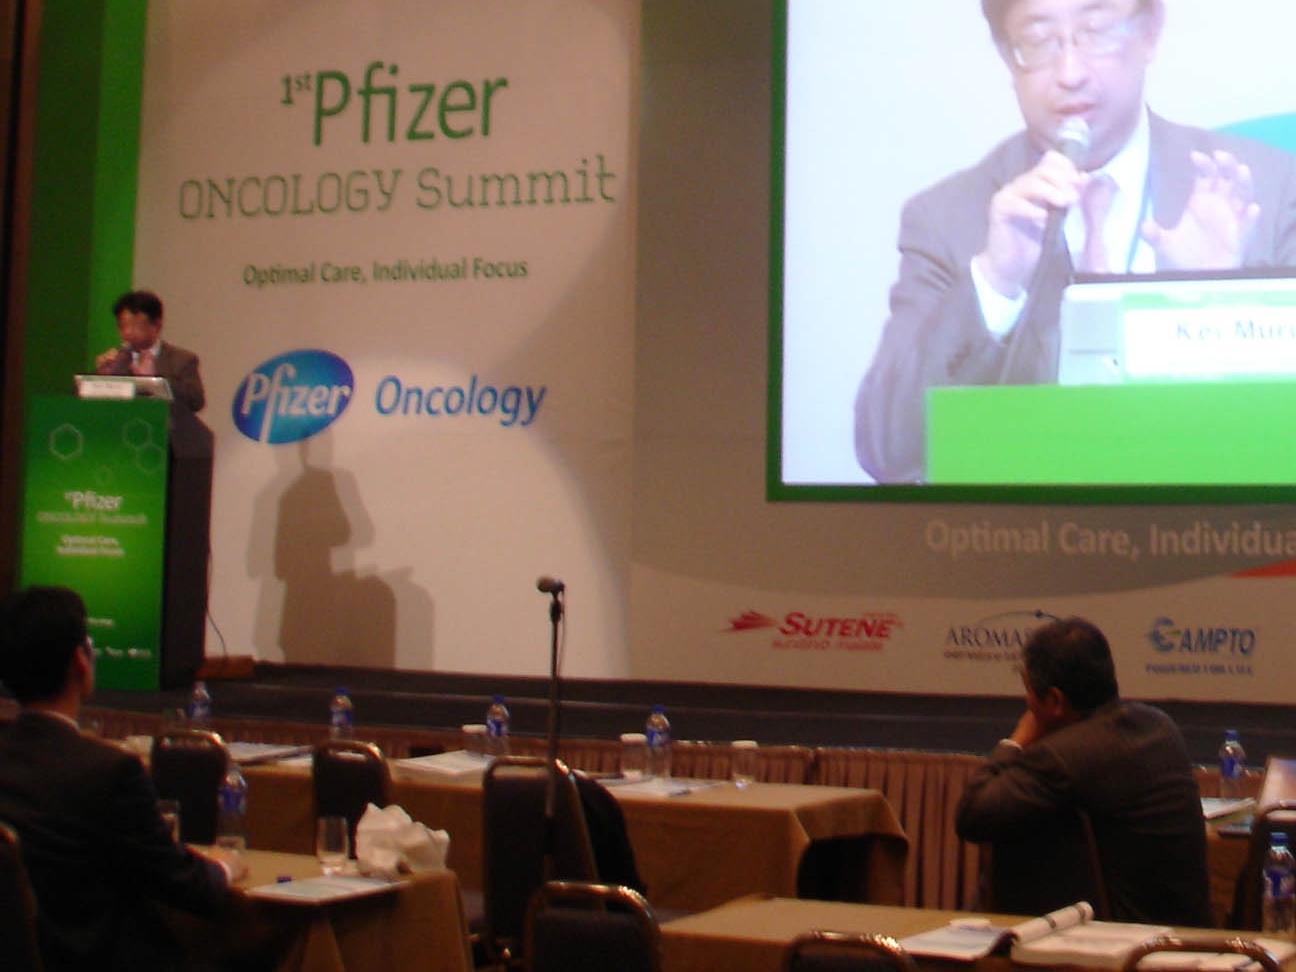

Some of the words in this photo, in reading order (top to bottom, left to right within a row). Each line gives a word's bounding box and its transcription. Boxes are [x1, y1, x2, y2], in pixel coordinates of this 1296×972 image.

[180, 168, 402, 220] ONCOLOGY
[416, 154, 617, 210] Summit
[242, 262, 316, 287] Optimal
[320, 261, 366, 285] Care,
[372, 257, 467, 283] Individual
[473, 257, 528, 281] Focus
[240, 365, 351, 444] Pfizer
[375, 376, 546, 426] Oncology
[925, 521, 1049, 557] Optimal
[1057, 522, 1140, 560] Care,
